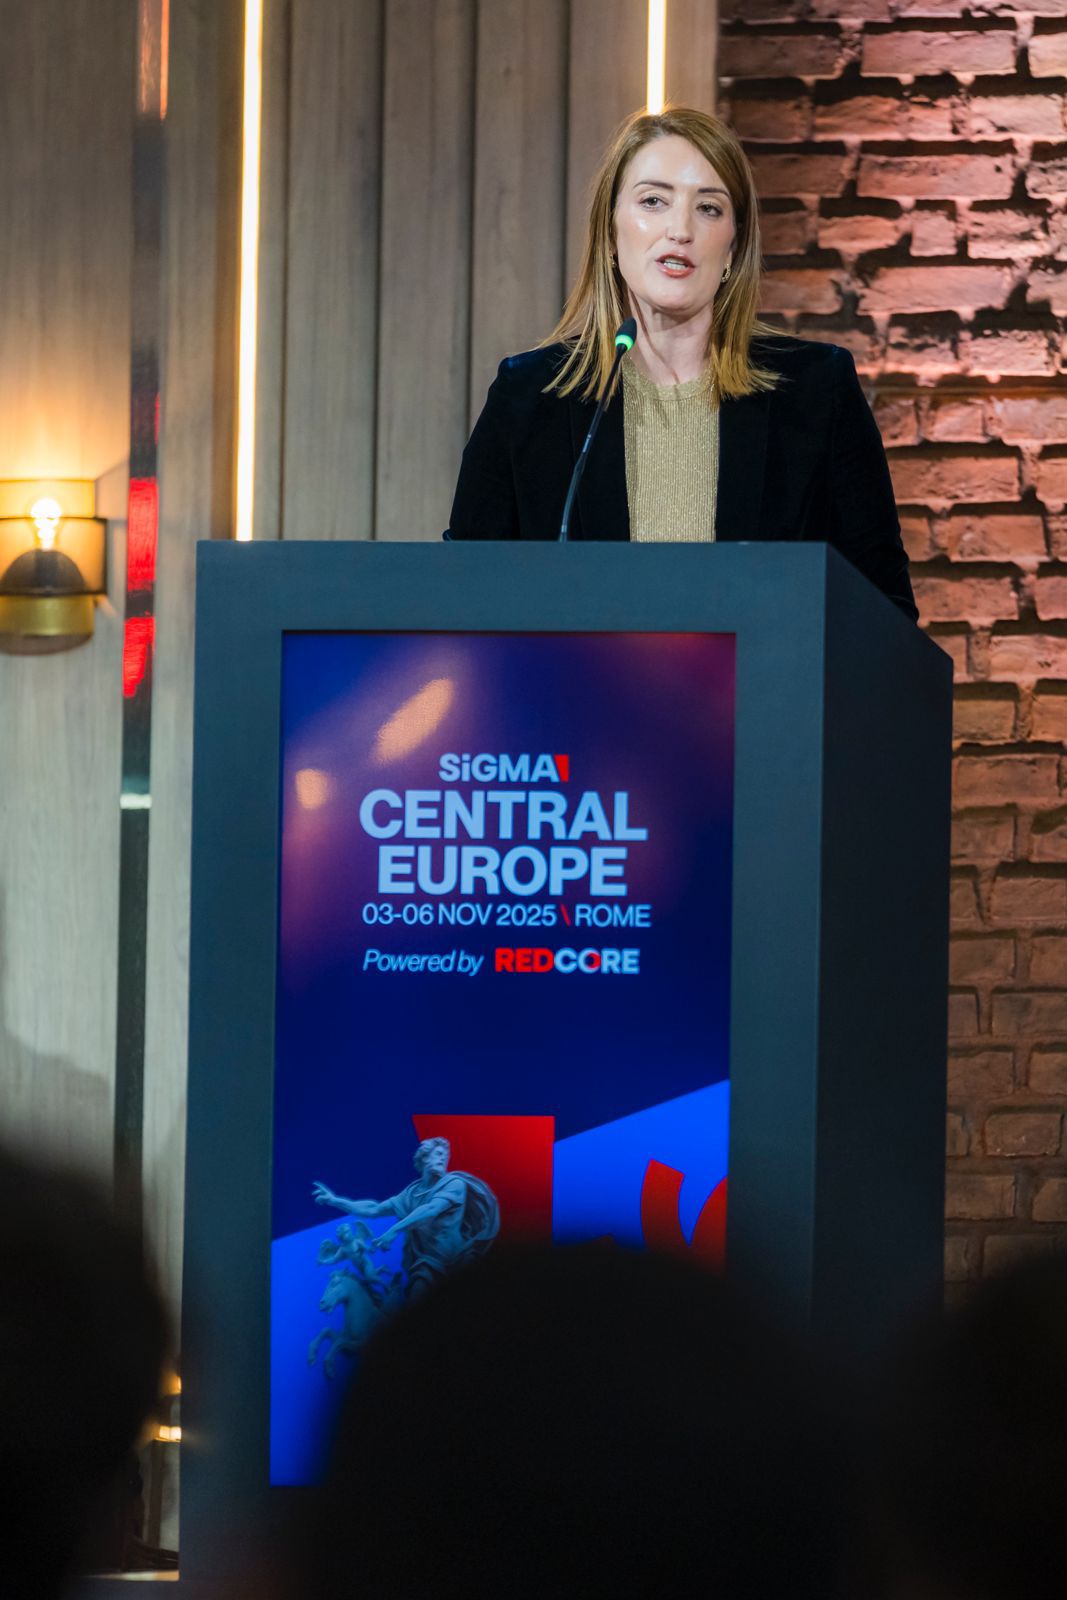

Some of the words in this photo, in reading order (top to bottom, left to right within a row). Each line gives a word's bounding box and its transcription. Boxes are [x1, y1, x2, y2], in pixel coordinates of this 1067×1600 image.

[439, 753, 561, 782] SiGMA
[359, 789, 648, 840] CENTRAL
[378, 845, 628, 896] EUROPE
[362, 903, 433, 925] 03-06
[438, 903, 493, 925] NOV
[496, 904, 557, 926] 2025
[575, 904, 652, 927] ROME
[362, 949, 457, 972] Powered
[457, 950, 484, 976] by
[495, 948, 640, 974] REDCORE
